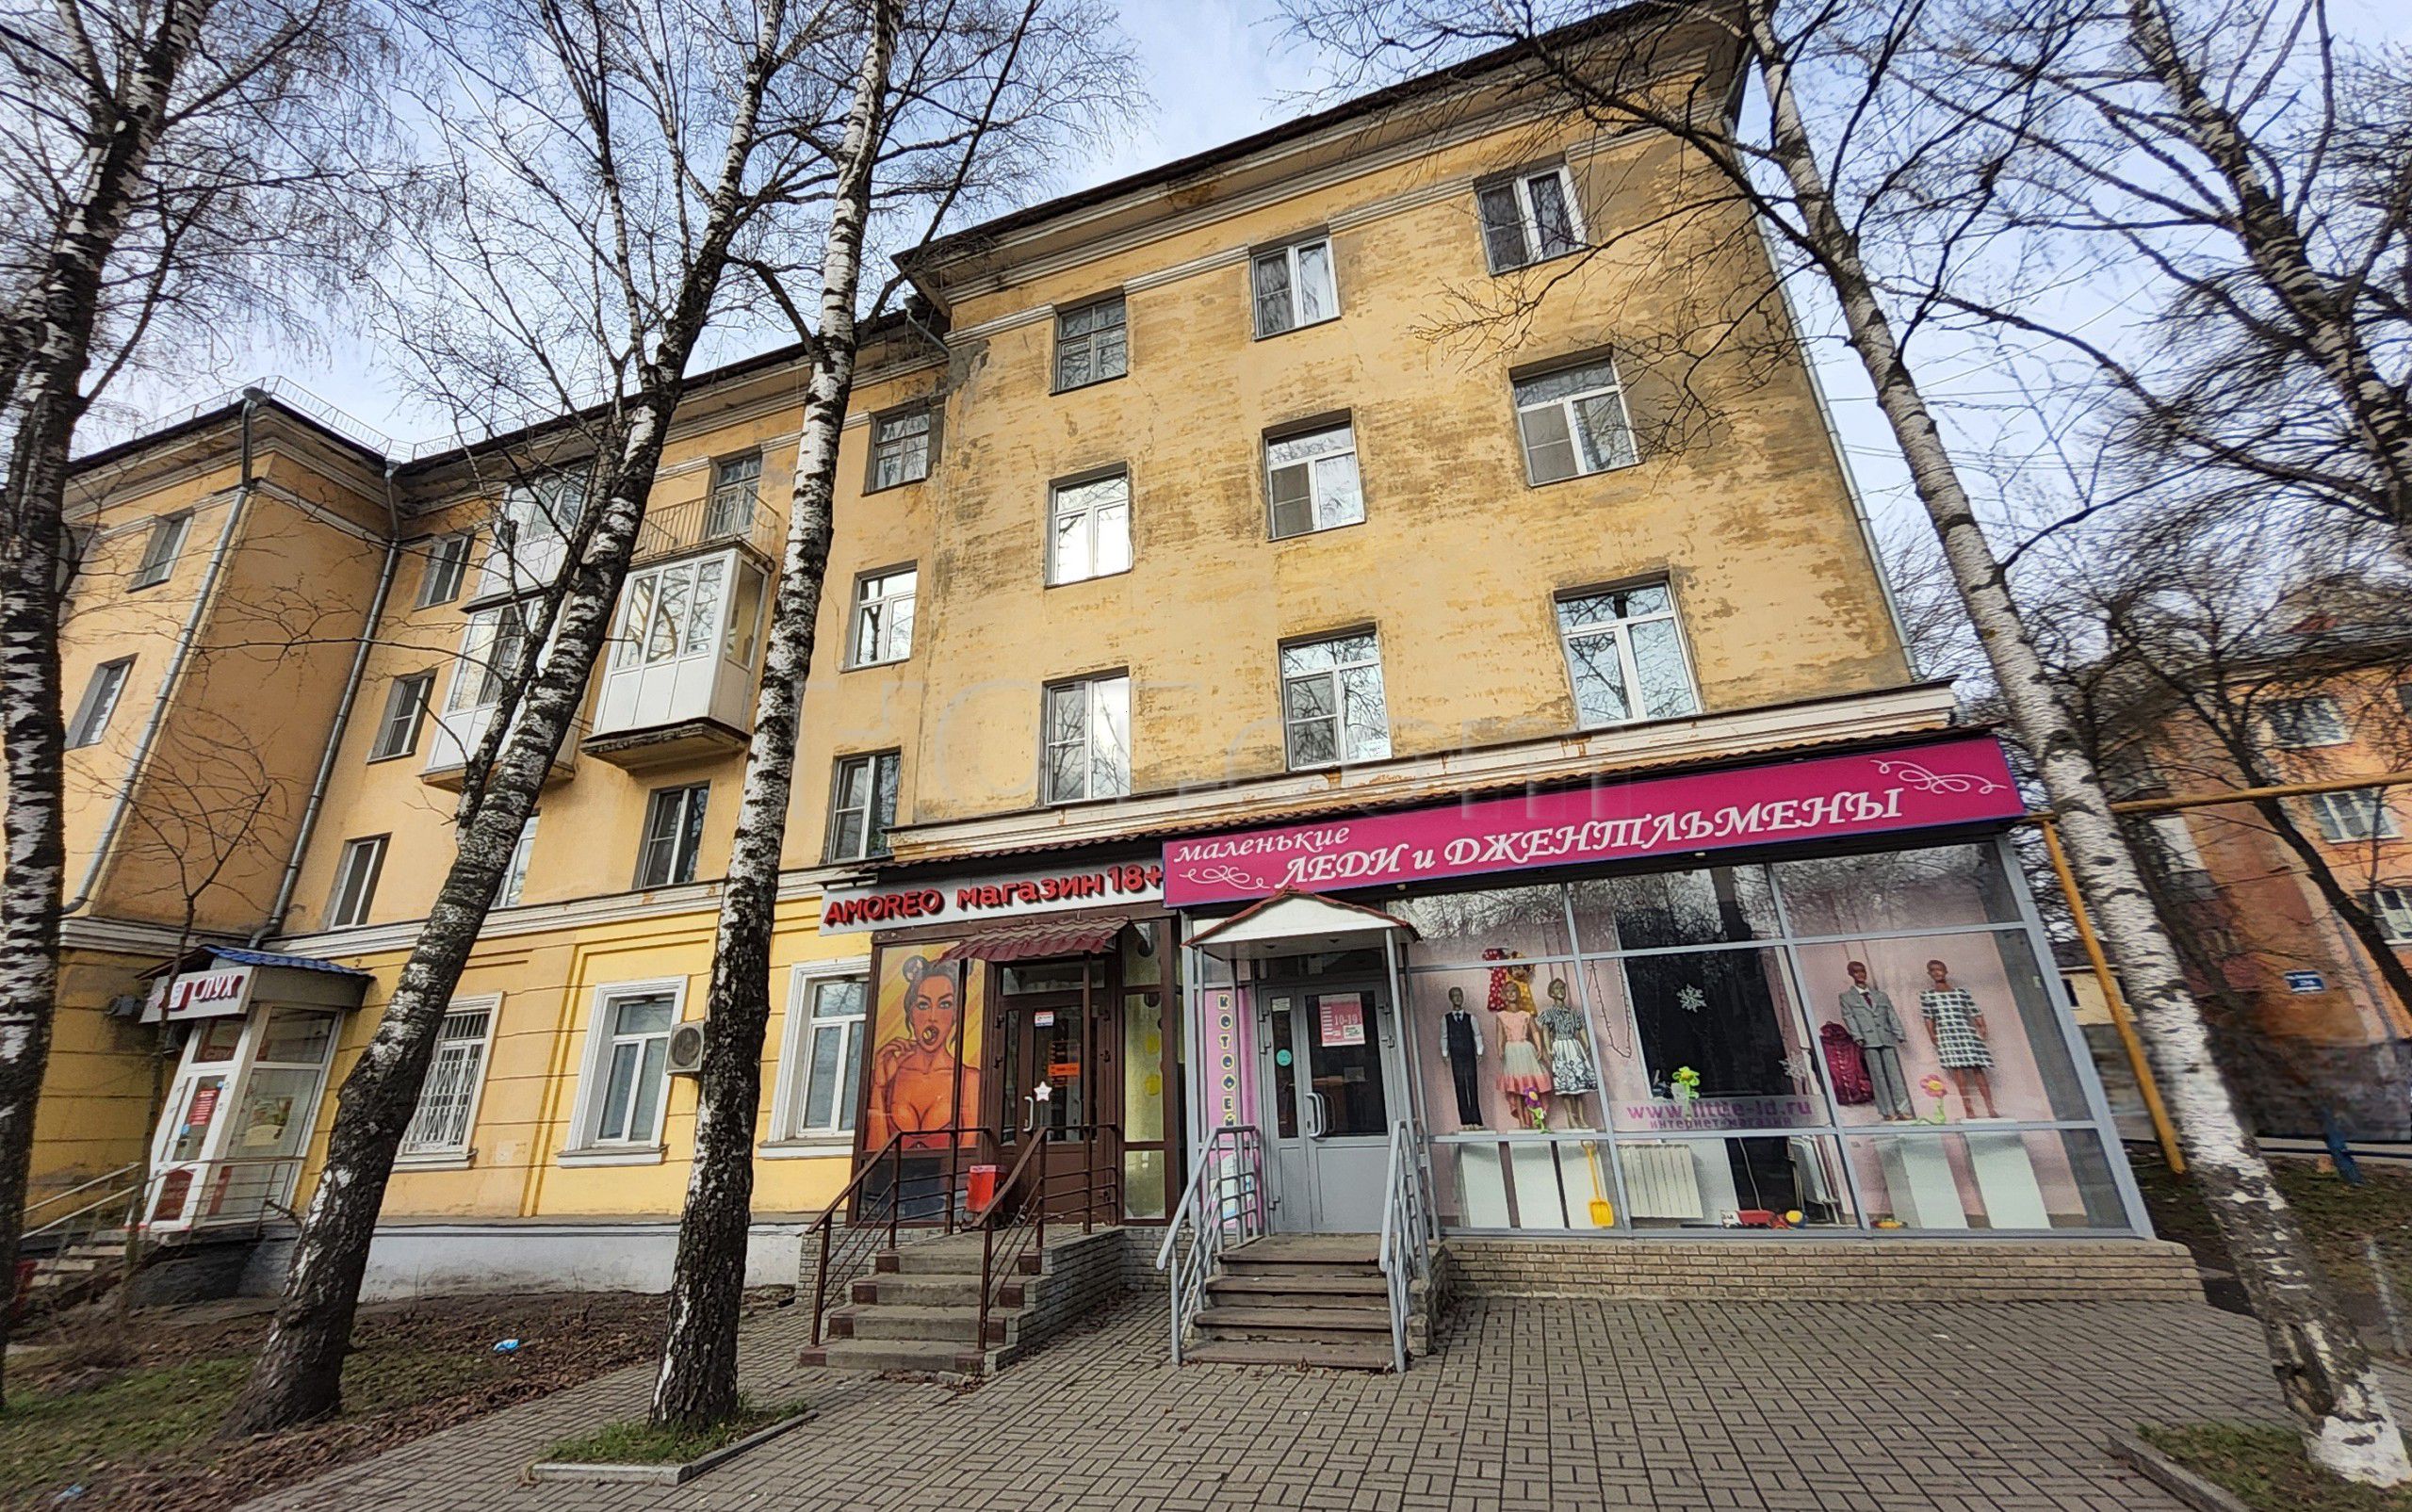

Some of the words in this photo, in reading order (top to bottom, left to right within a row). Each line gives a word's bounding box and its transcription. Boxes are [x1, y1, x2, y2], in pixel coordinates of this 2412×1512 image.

[1173, 825, 1349, 864] маленькие
[1274, 843, 1410, 889] ЛЕДИ
[1411, 849, 1438, 870] и
[1443, 788, 1905, 866] ДЖЕНТЛЬМЕНЫ
[823, 888, 945, 928] AMOREO
[956, 873, 1105, 912] магазин
[1106, 864, 1163, 894] 18+
[190, 974, 244, 1002] СЛУХ
[1650, 1117, 1792, 1130] интернет-магазин
